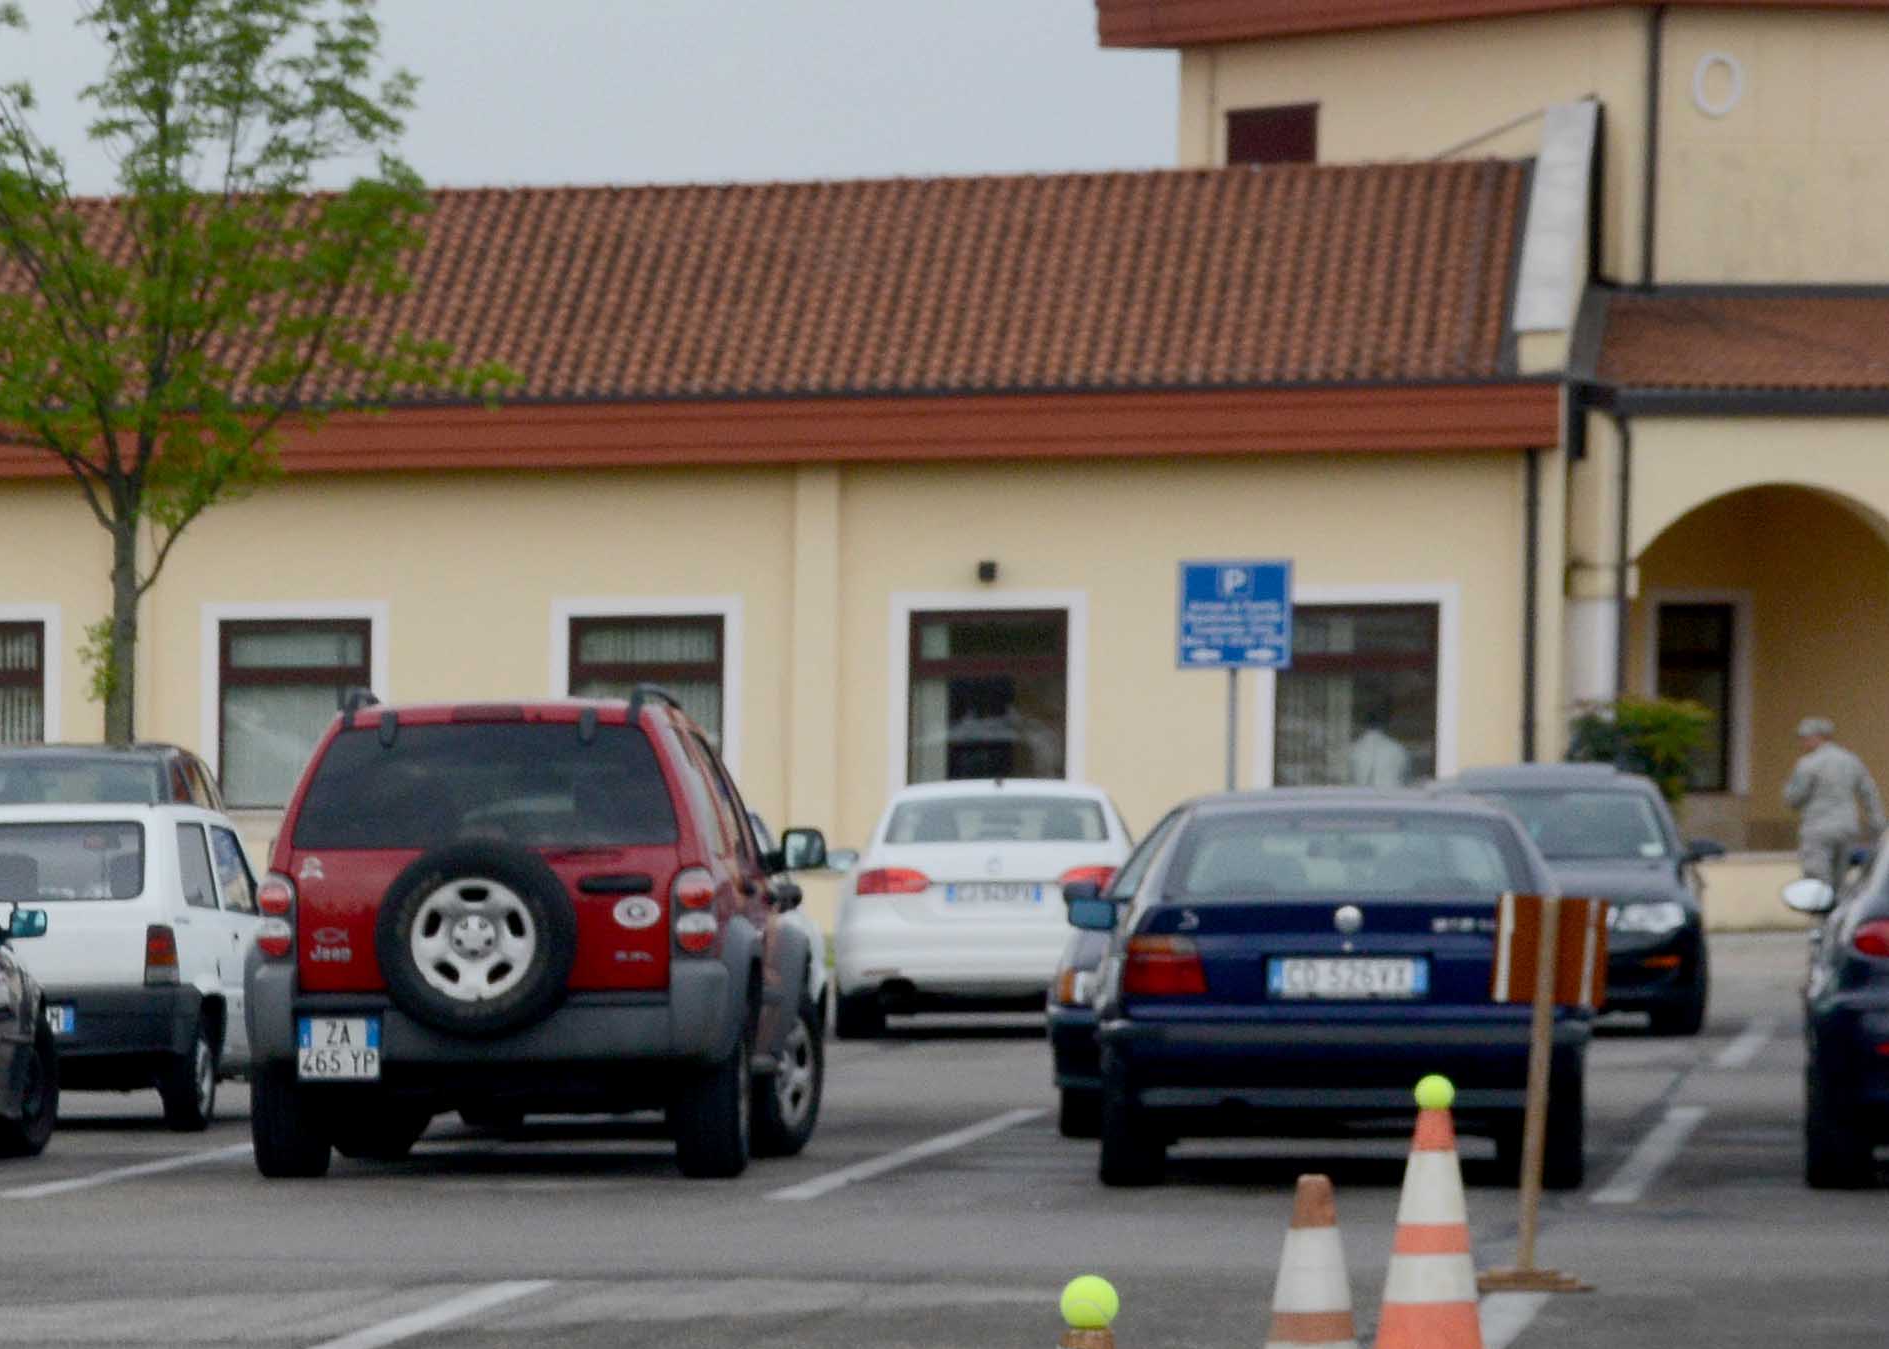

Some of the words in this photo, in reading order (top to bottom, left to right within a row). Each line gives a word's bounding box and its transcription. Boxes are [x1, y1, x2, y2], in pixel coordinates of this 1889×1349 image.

[1223, 569, 1248, 596] P
[310, 947, 353, 963] Jeep
[325, 1020, 351, 1046] ZA
[351, 1053, 375, 1074] YP
